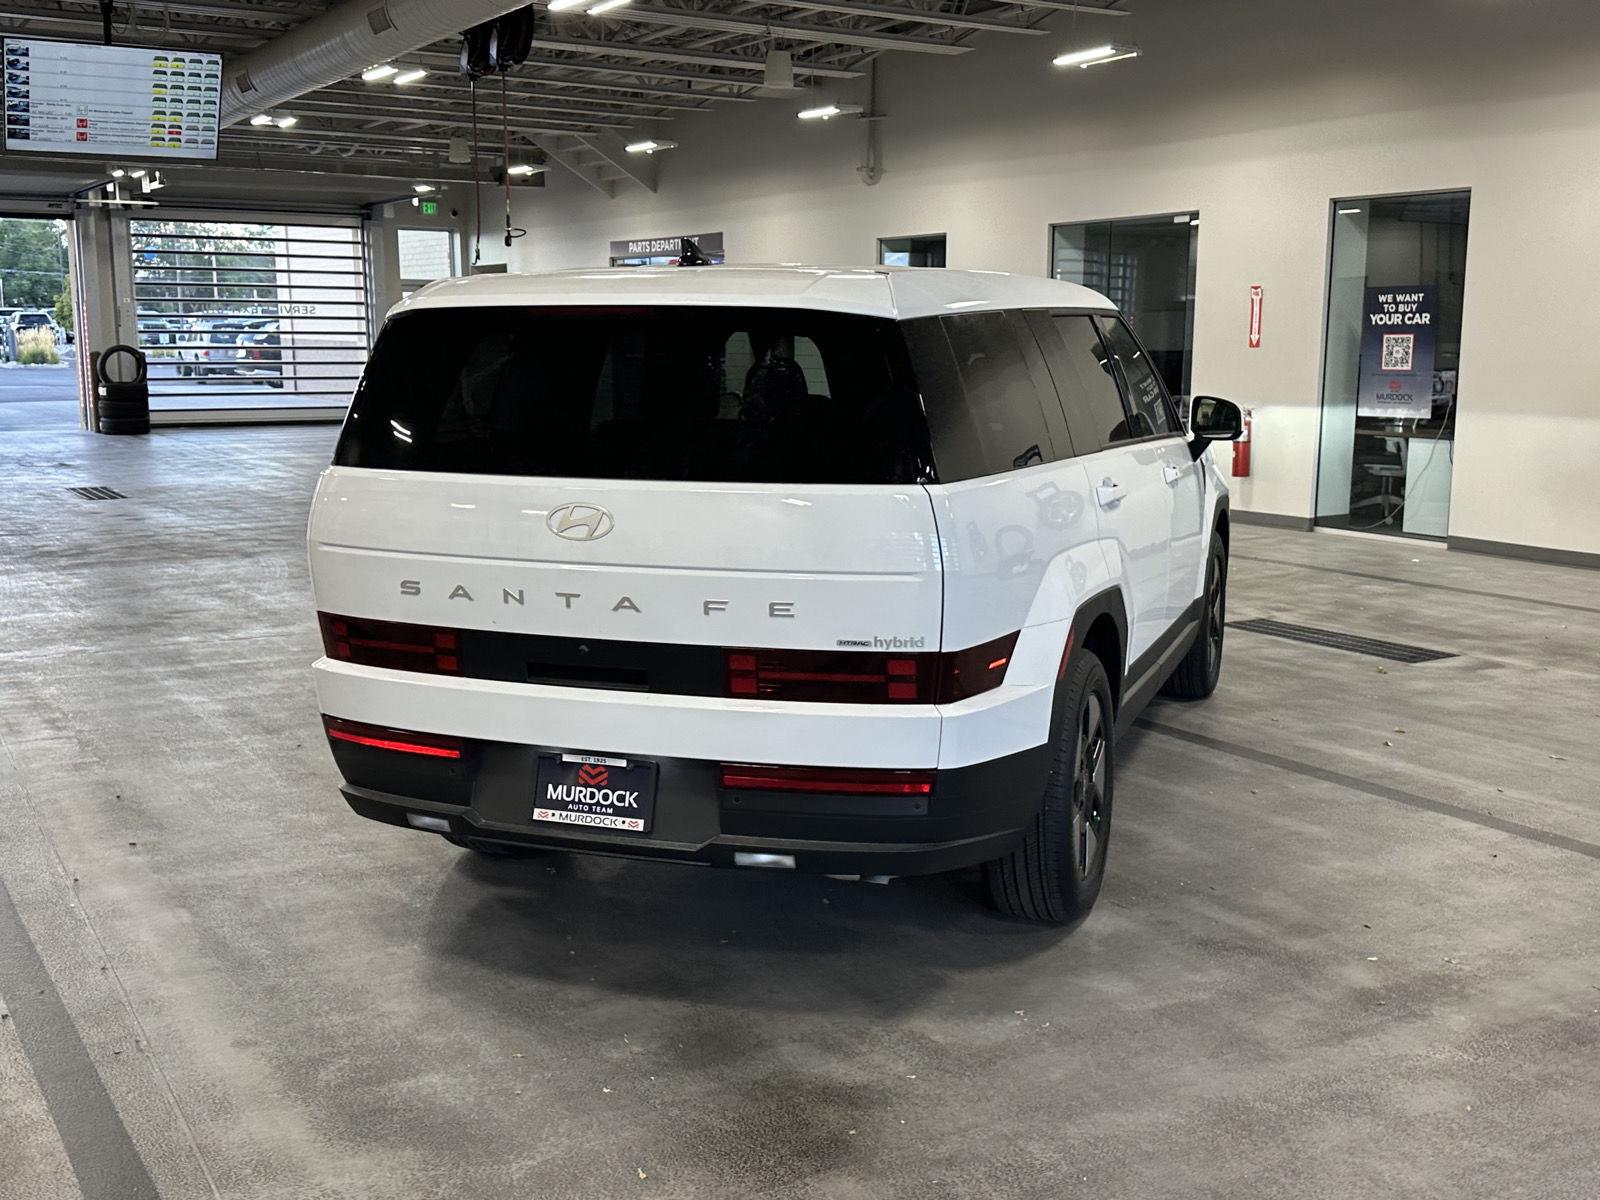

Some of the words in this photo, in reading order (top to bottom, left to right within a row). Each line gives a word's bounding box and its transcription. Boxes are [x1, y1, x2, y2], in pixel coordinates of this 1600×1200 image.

[423, 202, 437, 214] EXIT
[628, 241, 650, 254] PARTS
[651, 236, 700, 252] DEPARTT
[1378, 294, 1394, 303] WE
[1396, 293, 1424, 302] WANT
[1383, 304, 1396, 312] TO
[1398, 303, 1418, 312] BUY
[1370, 314, 1402, 325] YOUR
[1404, 313, 1431, 325] CAR
[1376, 393, 1413, 402] MURDOCK
[400, 580, 642, 614] SANTA
[703, 599, 796, 618] FE
[873, 636, 925, 650] hybrid
[547, 783, 639, 808] MURDOCK
[567, 803, 589, 812] AUTO
[591, 805, 614, 814] TEAM
[558, 812, 619, 827] MURDOCK
